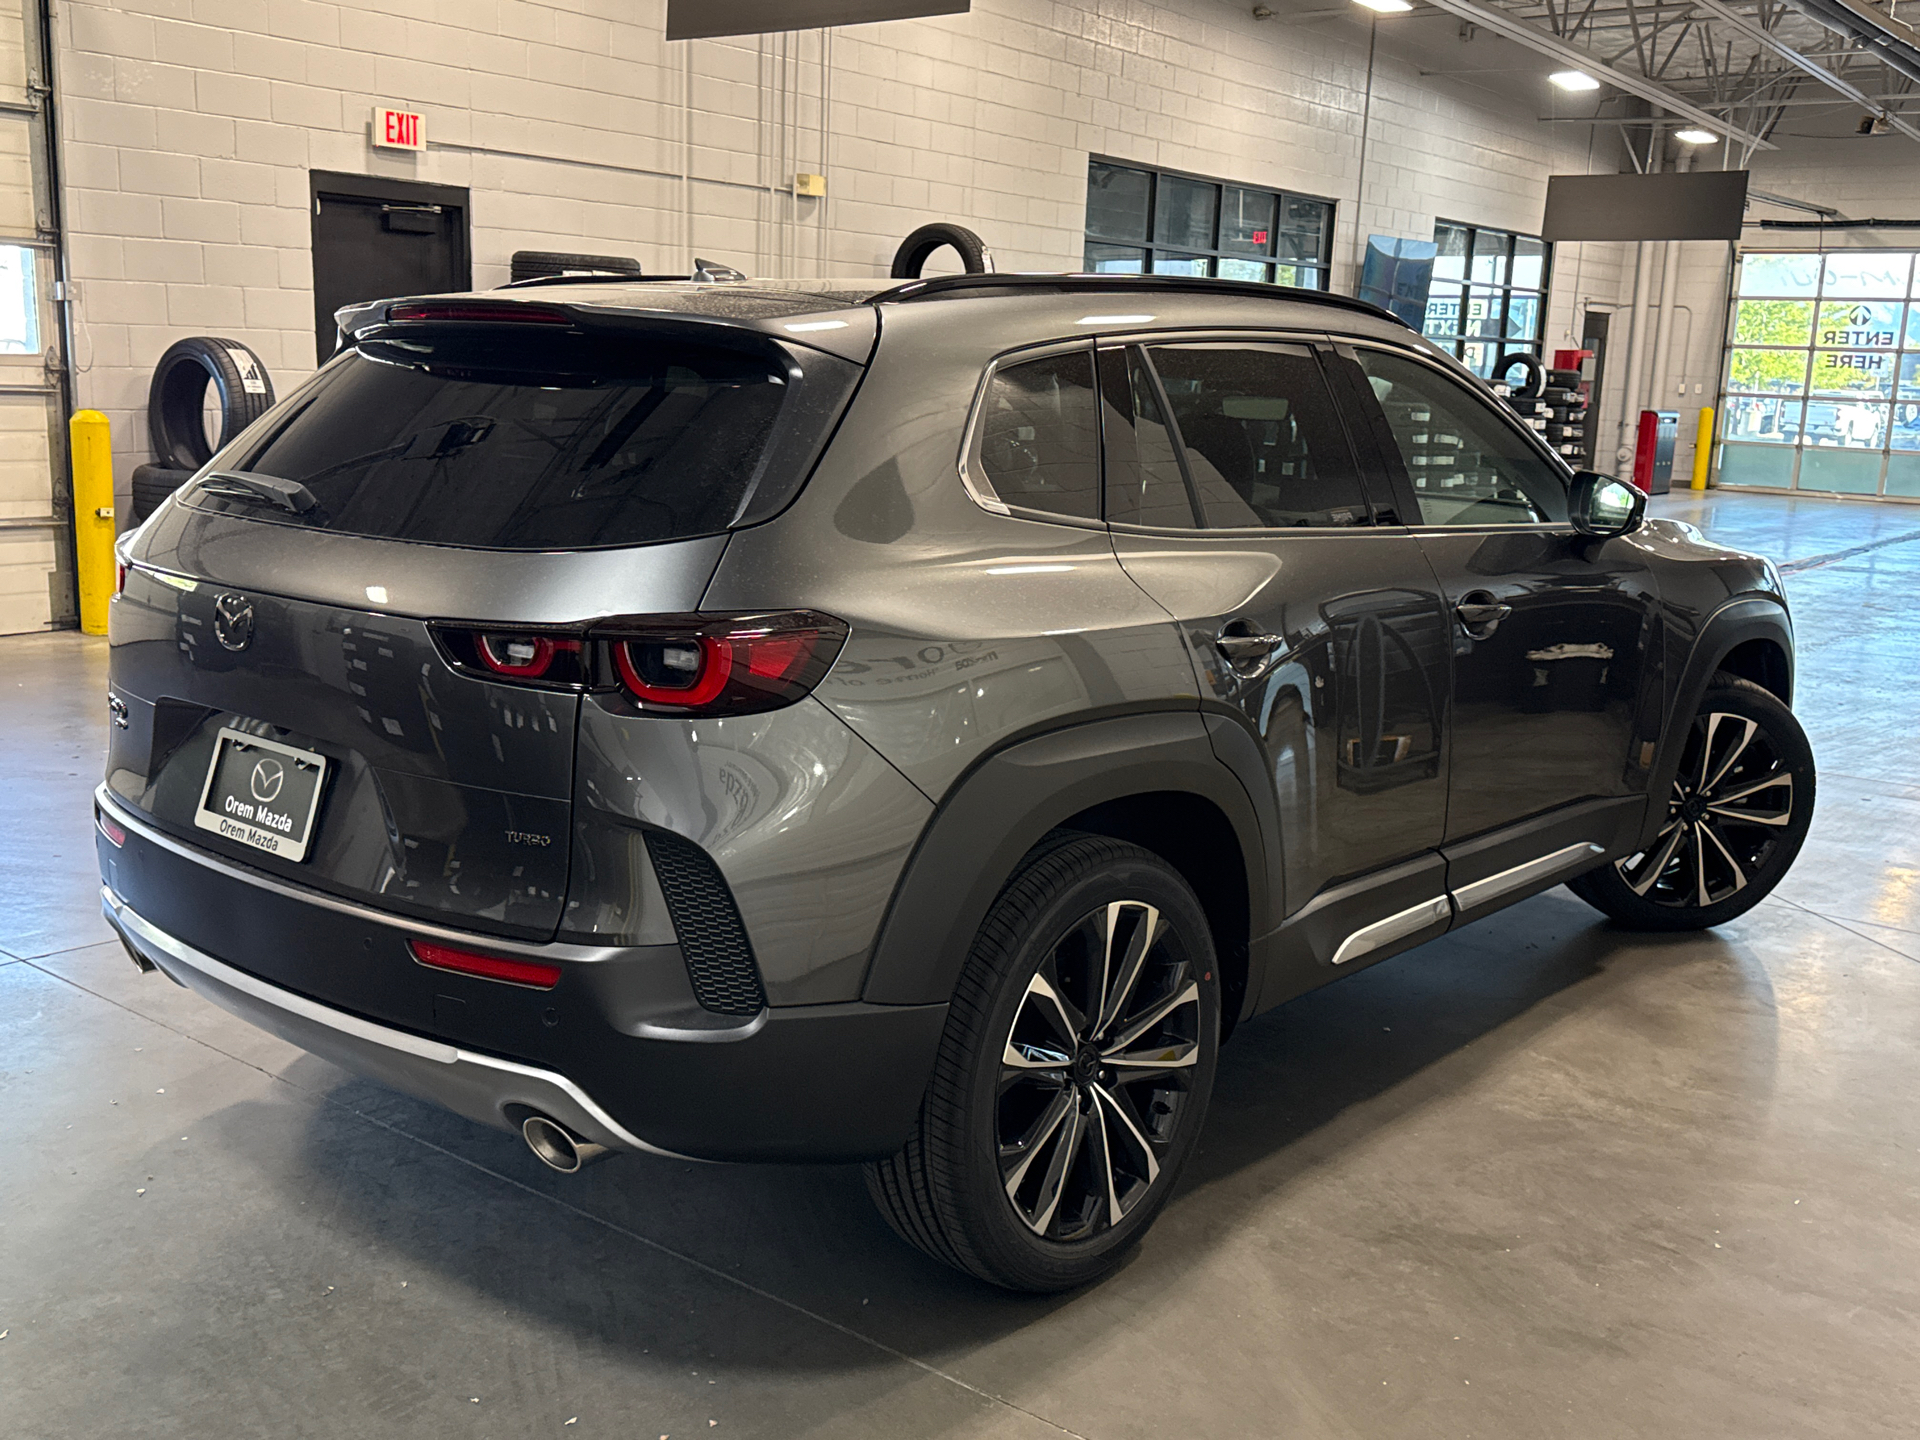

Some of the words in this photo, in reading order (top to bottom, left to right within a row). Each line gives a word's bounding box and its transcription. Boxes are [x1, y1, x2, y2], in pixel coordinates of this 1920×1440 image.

[385, 111, 419, 147] EXIT
[225, 795, 254, 819] Orem
[255, 805, 293, 832] Mazda
[219, 819, 245, 840] Orem
[246, 828, 279, 851] Mazda
[504, 830, 551, 847] TURBO
